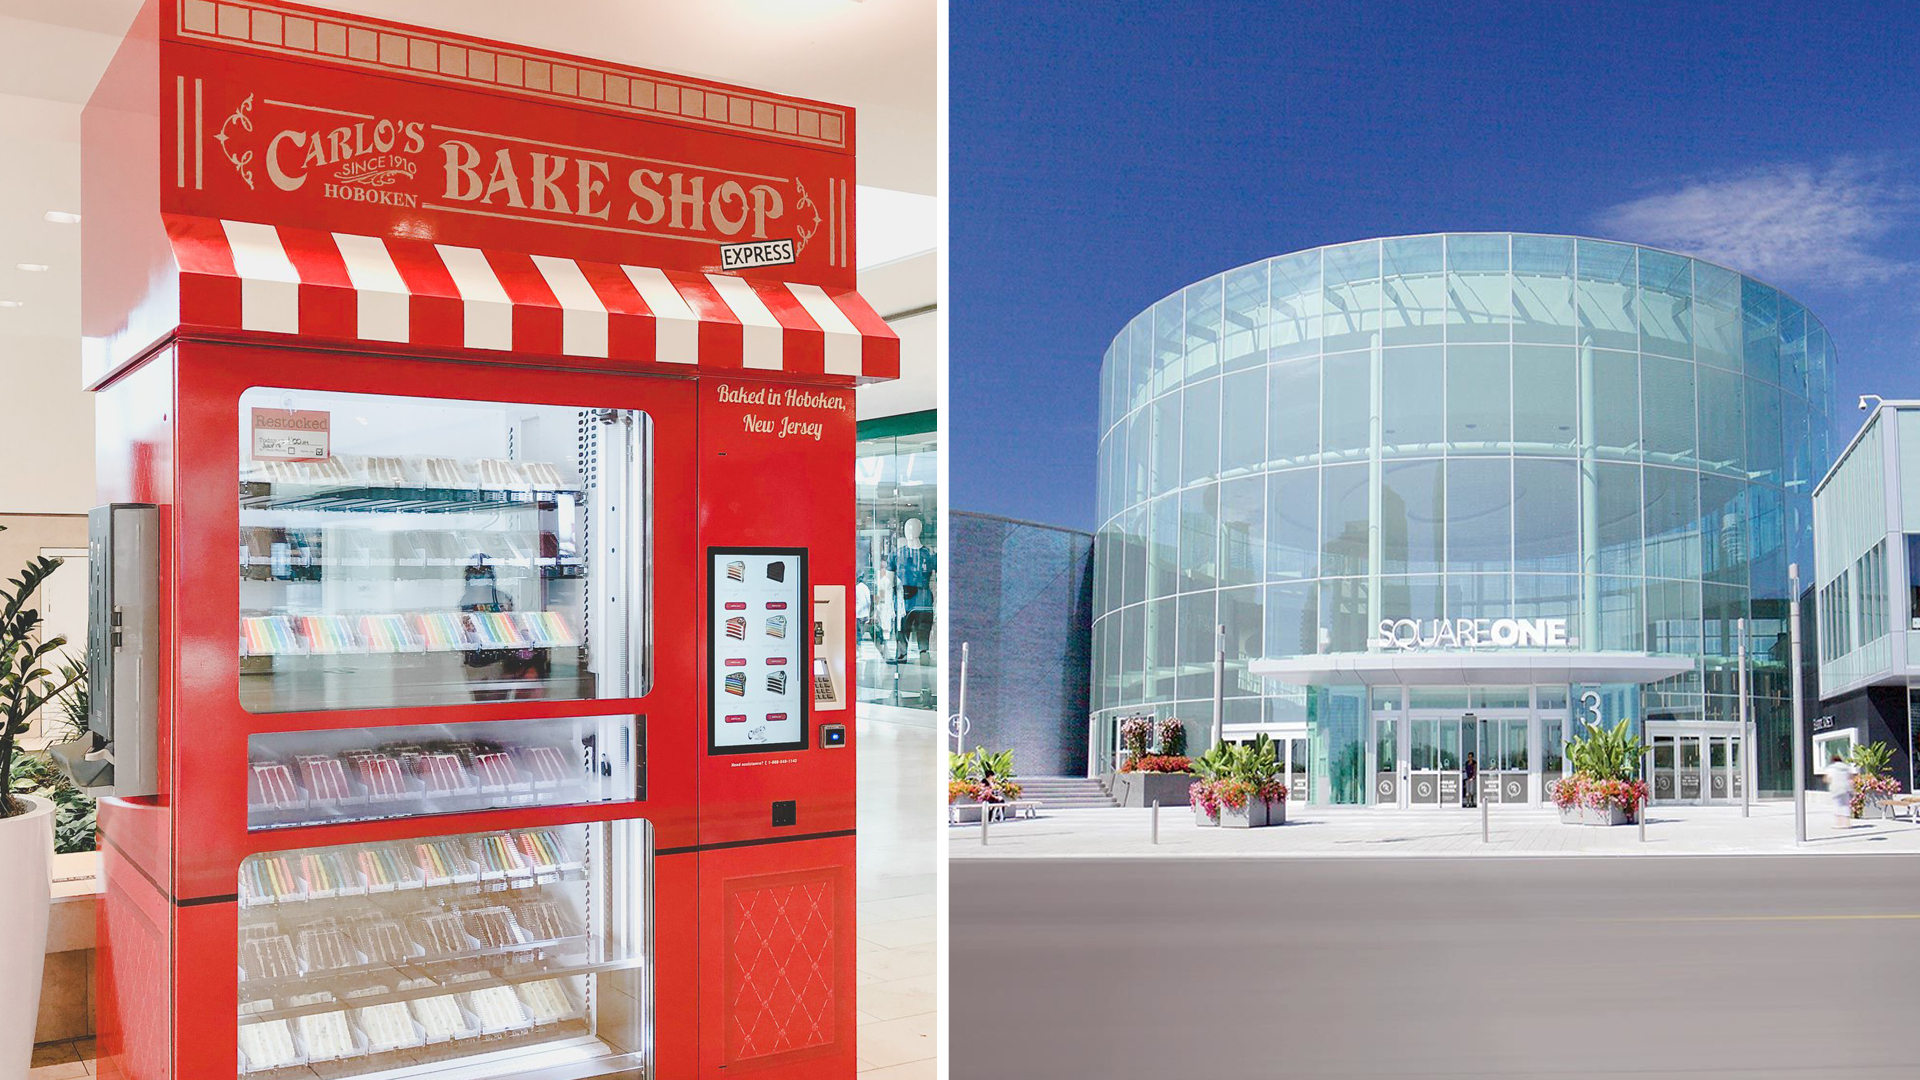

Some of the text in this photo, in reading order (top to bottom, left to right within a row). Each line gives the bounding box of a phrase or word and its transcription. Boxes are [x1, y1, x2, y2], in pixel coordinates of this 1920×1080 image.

[266, 119, 425, 191] CARLO'S
[342, 154, 417, 176] SINCE 1910
[324, 183, 418, 208] HOBOKEN
[438, 140, 783, 239] BAKE SHOP
[723, 243, 791, 266] EXPRESS
[717, 384, 846, 412] Baked in Hoboken,
[255, 414, 328, 430] Restocked
[743, 414, 823, 441] New Jersey
[1580, 691, 1602, 729] 3
